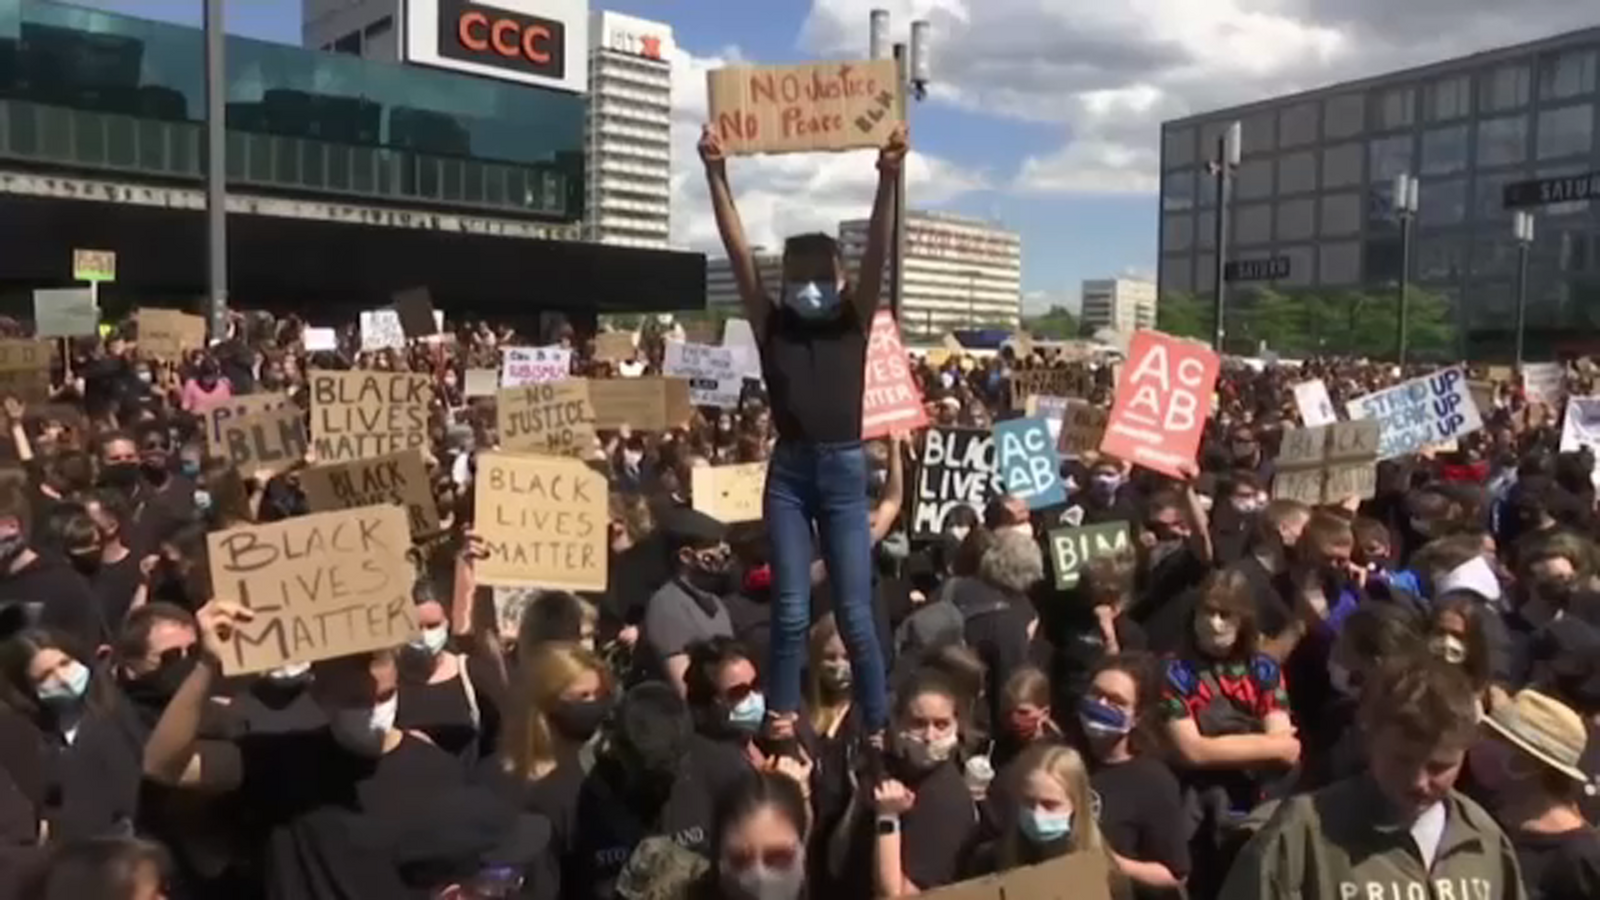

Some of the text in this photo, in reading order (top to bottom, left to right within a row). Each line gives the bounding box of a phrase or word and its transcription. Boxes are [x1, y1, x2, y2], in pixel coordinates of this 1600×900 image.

[459, 11, 551, 63] CCC
[751, 74, 799, 102] NO
[316, 376, 427, 404] BLACK
[1430, 369, 1460, 396] UP
[323, 406, 423, 432] LIVES
[505, 399, 596, 437] JUSTICE
[1434, 392, 1461, 417] UP
[1437, 414, 1464, 437] UP
[329, 460, 406, 499] BLACK
[490, 467, 591, 502] BLACK
[497, 504, 593, 538] LIVES
[220, 518, 391, 572] BLACK
[485, 541, 596, 570] MATTER
[238, 560, 390, 613] LIVES
[233, 595, 415, 669] MATTER
